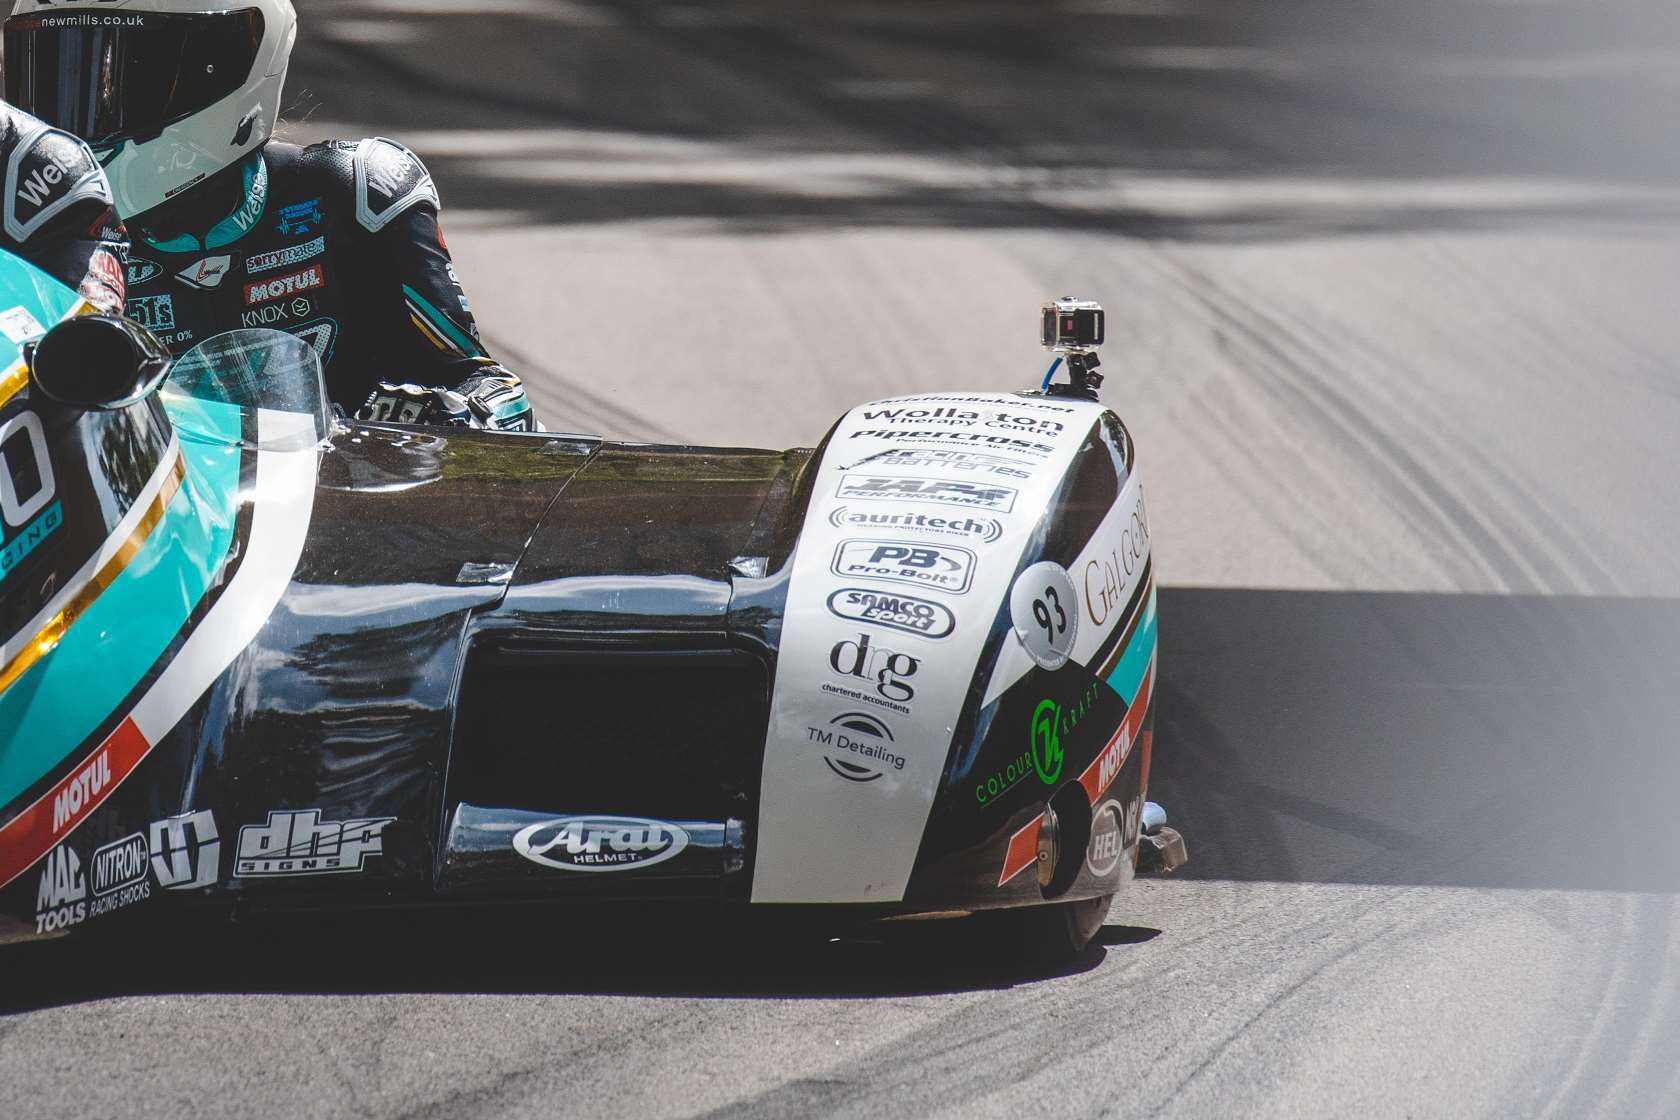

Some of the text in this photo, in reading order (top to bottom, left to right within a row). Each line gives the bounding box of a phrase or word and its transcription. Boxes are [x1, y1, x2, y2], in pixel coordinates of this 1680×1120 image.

[41, 14, 144, 27] newmills.co.uk
[232, 172, 264, 231] Weise
[249, 269, 319, 302] MOTUL
[241, 303, 288, 328] KNOX
[863, 407, 1064, 432] Wollaton
[889, 416, 1059, 438] Therapy Centre
[849, 429, 1056, 454] pipercross
[842, 489, 1001, 507] PERFORMANCE
[849, 512, 983, 535] auritech
[868, 546, 940, 569] PB
[846, 592, 936, 619] SAMCO
[866, 608, 930, 629] sport
[1032, 586, 1067, 646] 93
[822, 683, 911, 714] chartered accountants
[808, 727, 906, 770] TM Detailing
[975, 751, 1033, 802] COLOUR
[52, 750, 111, 835] MOTUL
[527, 821, 671, 857] Arai
[1093, 830, 1119, 861] HEL
[240, 857, 341, 872] SIGNS
[573, 852, 637, 865] HELMET
[89, 881, 151, 918] RACING SHOCKS
[36, 901, 87, 934] TOOLS
